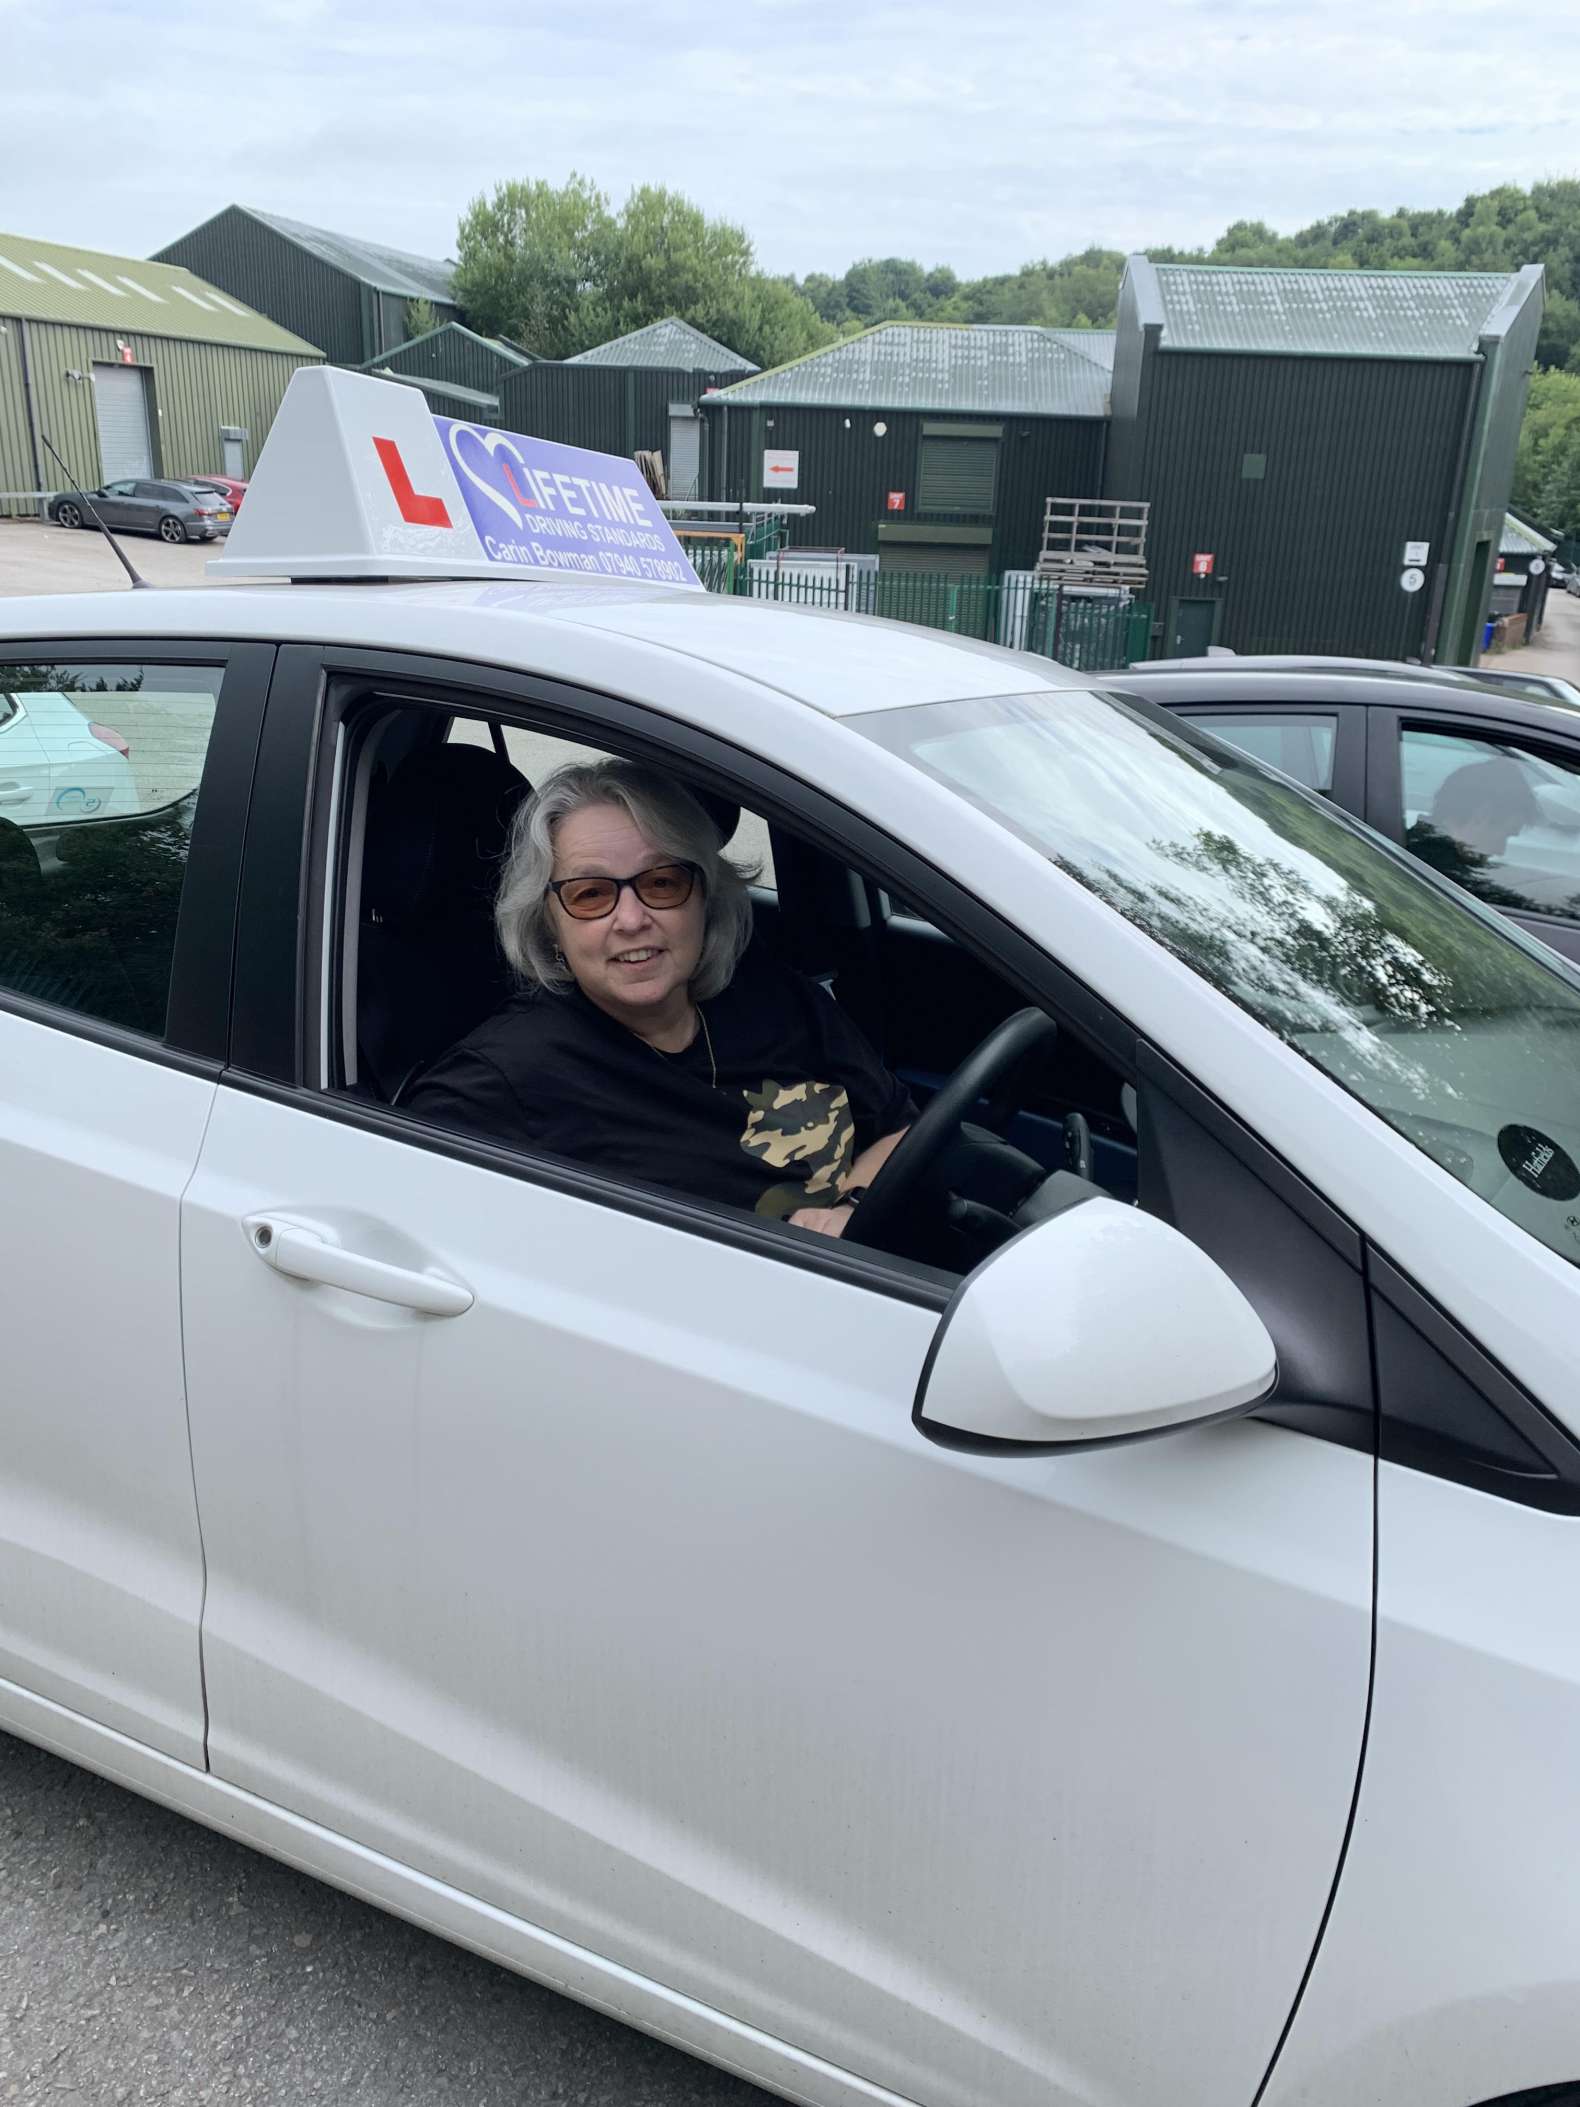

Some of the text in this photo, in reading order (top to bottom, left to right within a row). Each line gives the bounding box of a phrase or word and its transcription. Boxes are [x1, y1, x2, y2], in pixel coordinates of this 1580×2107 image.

[372, 436, 454, 528] L
[504, 463, 652, 526] LIFETIME
[484, 535, 688, 582] Carin Bowman 07940 578902
[525, 514, 666, 552] DRIVING STANDARDS
